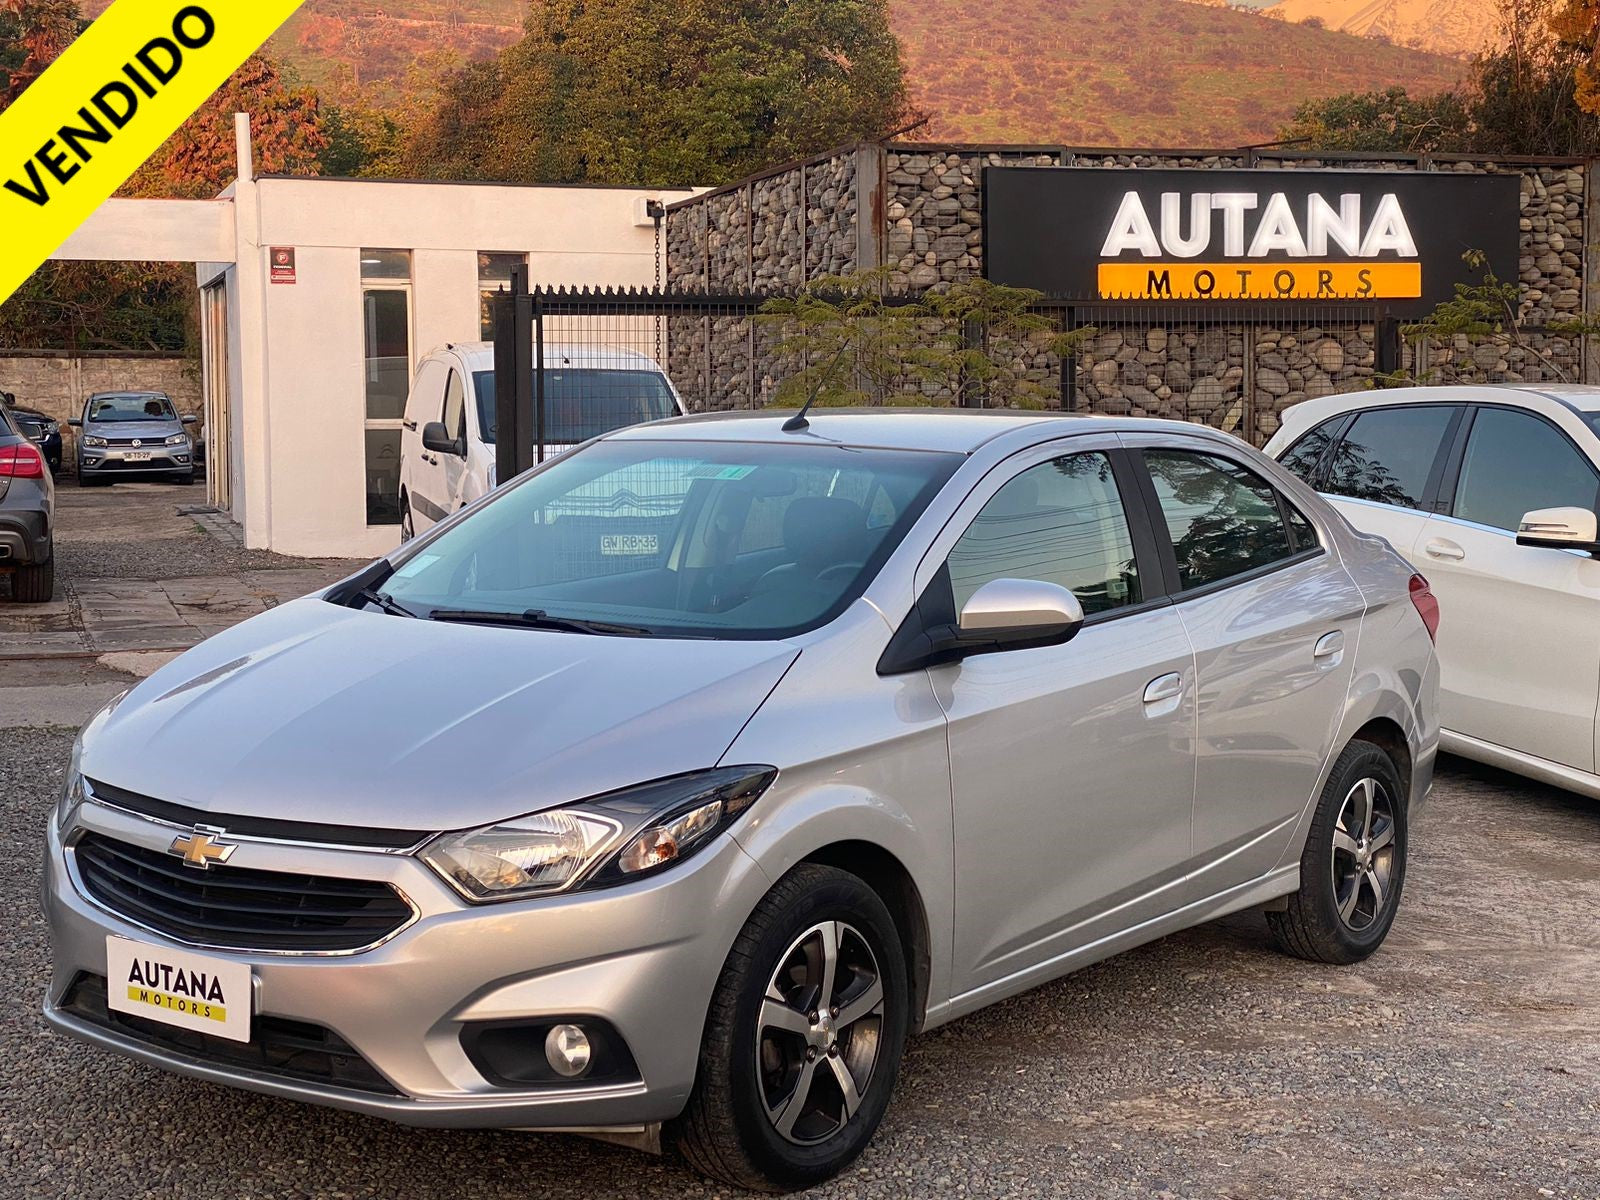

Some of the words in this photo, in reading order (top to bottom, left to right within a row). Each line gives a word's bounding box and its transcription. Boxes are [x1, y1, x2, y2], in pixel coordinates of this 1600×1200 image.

[1099, 190, 1419, 257] AUTANA
[1146, 269, 1373, 296] MOTORS
[128, 957, 225, 1004] AUTANA
[140, 990, 211, 1018] MOTORS
